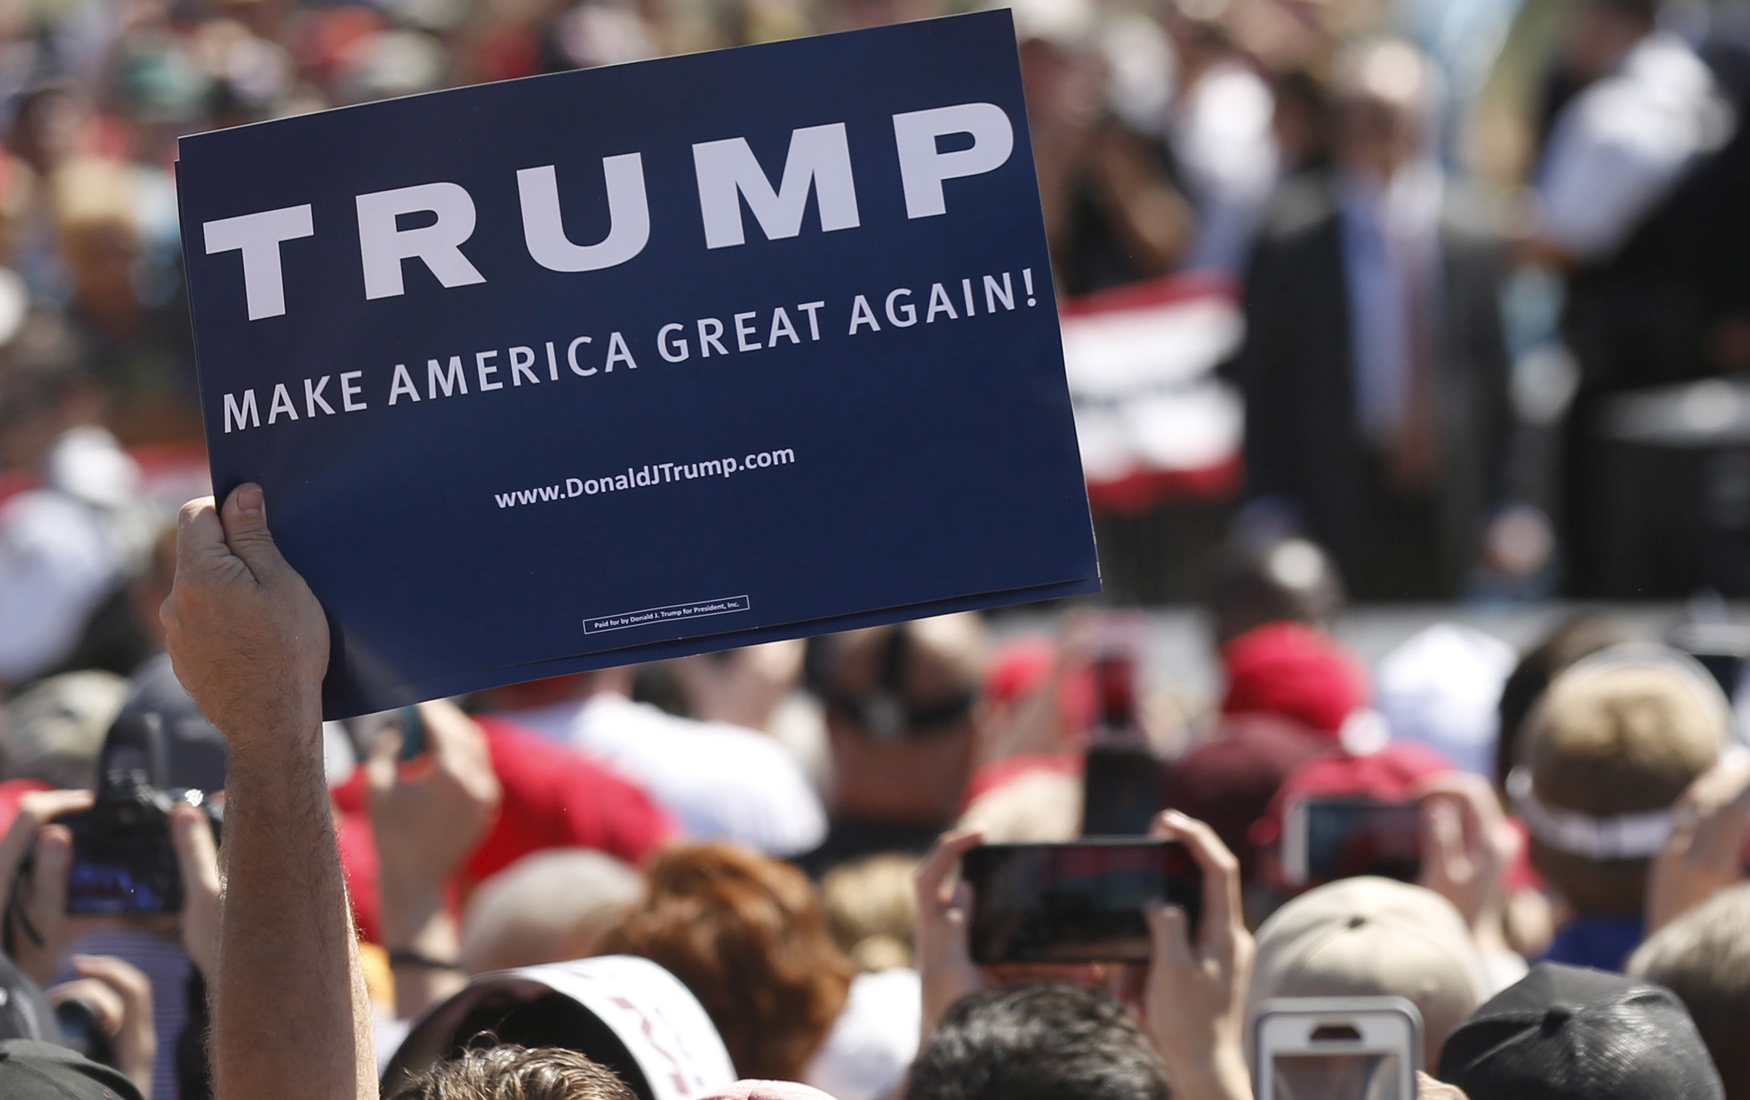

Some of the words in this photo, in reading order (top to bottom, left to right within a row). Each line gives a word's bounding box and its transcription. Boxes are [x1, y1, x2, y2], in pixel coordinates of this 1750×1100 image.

[202, 102, 1014, 321] TRUMP
[223, 370, 369, 434] MAKE
[388, 331, 638, 406] AMERICA
[656, 300, 825, 363] GREAT
[848, 267, 1037, 336] AGAIN!
[494, 448, 796, 509] www.DonaldJTrump.com
[594, 620, 609, 629] Paid
[629, 612, 654, 623] Donald
[660, 610, 682, 618] Trump
[693, 603, 727, 613] President,
